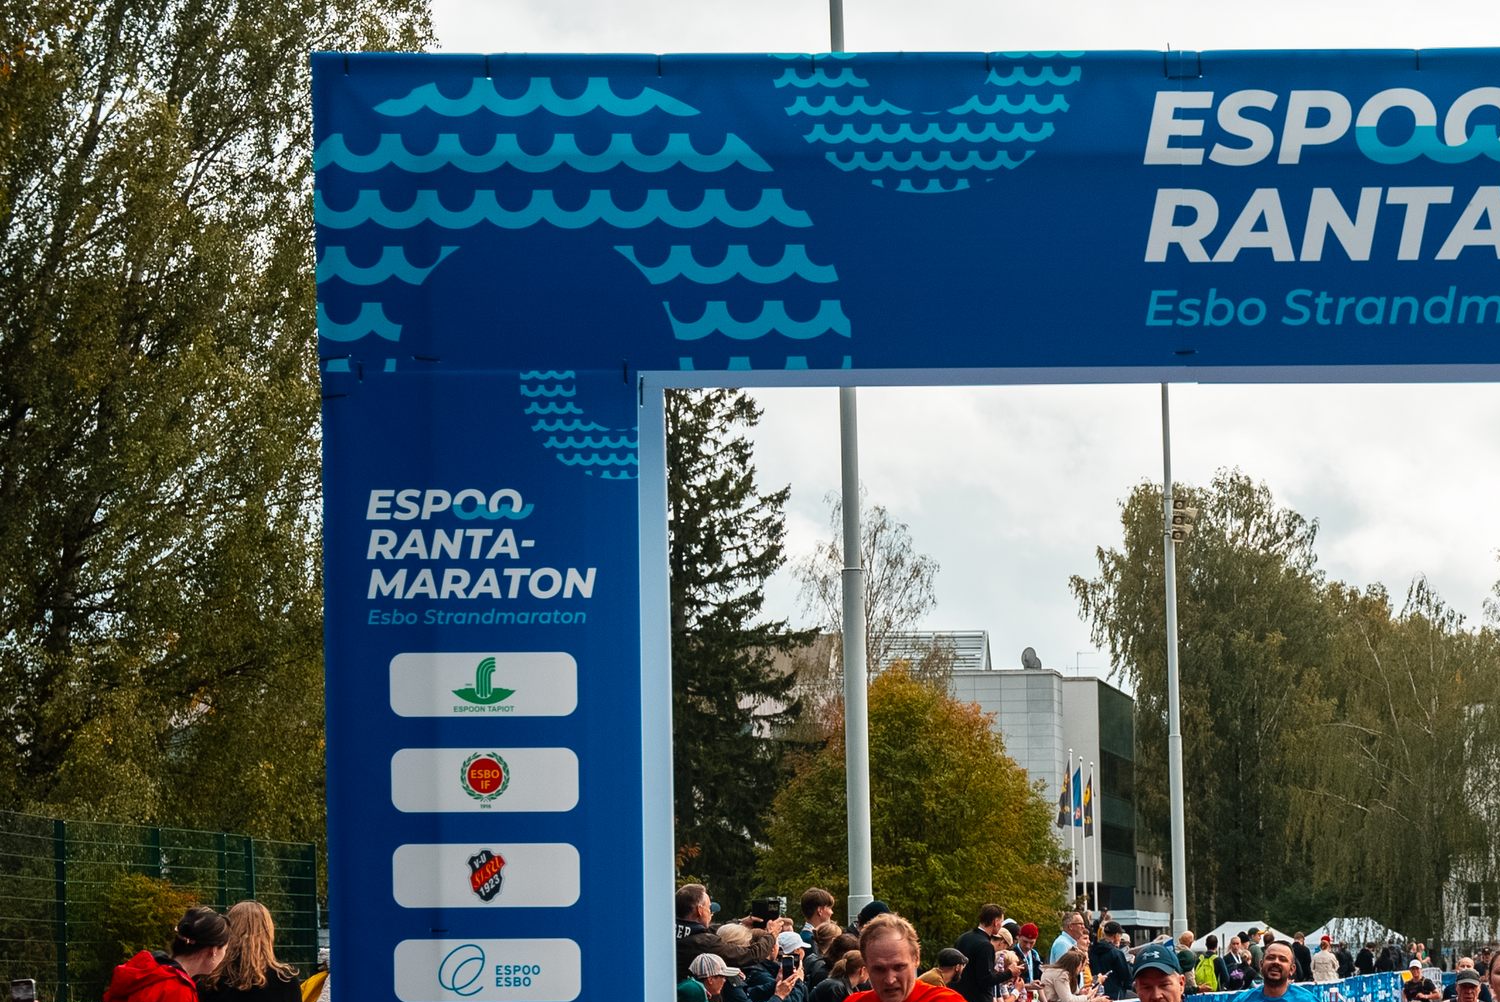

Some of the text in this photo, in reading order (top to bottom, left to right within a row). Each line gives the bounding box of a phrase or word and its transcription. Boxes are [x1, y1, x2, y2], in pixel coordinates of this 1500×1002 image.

[1144, 287, 1267, 327] Esbo
[365, 488, 535, 521] ESPOO
[366, 528, 536, 560] RANTA-
[366, 567, 597, 600] MARATON
[367, 608, 588, 626] Esbo Strandmaraton
[453, 705, 515, 713] ESPOON TAPIOT
[470, 769, 500, 779] ESBO
[480, 780, 491, 790] IF
[473, 853, 487, 869] V-U
[480, 874, 500, 896] 1923
[675, 924, 692, 939] ER
[495, 964, 541, 976] ESPOO
[495, 976, 532, 988] ESBO
